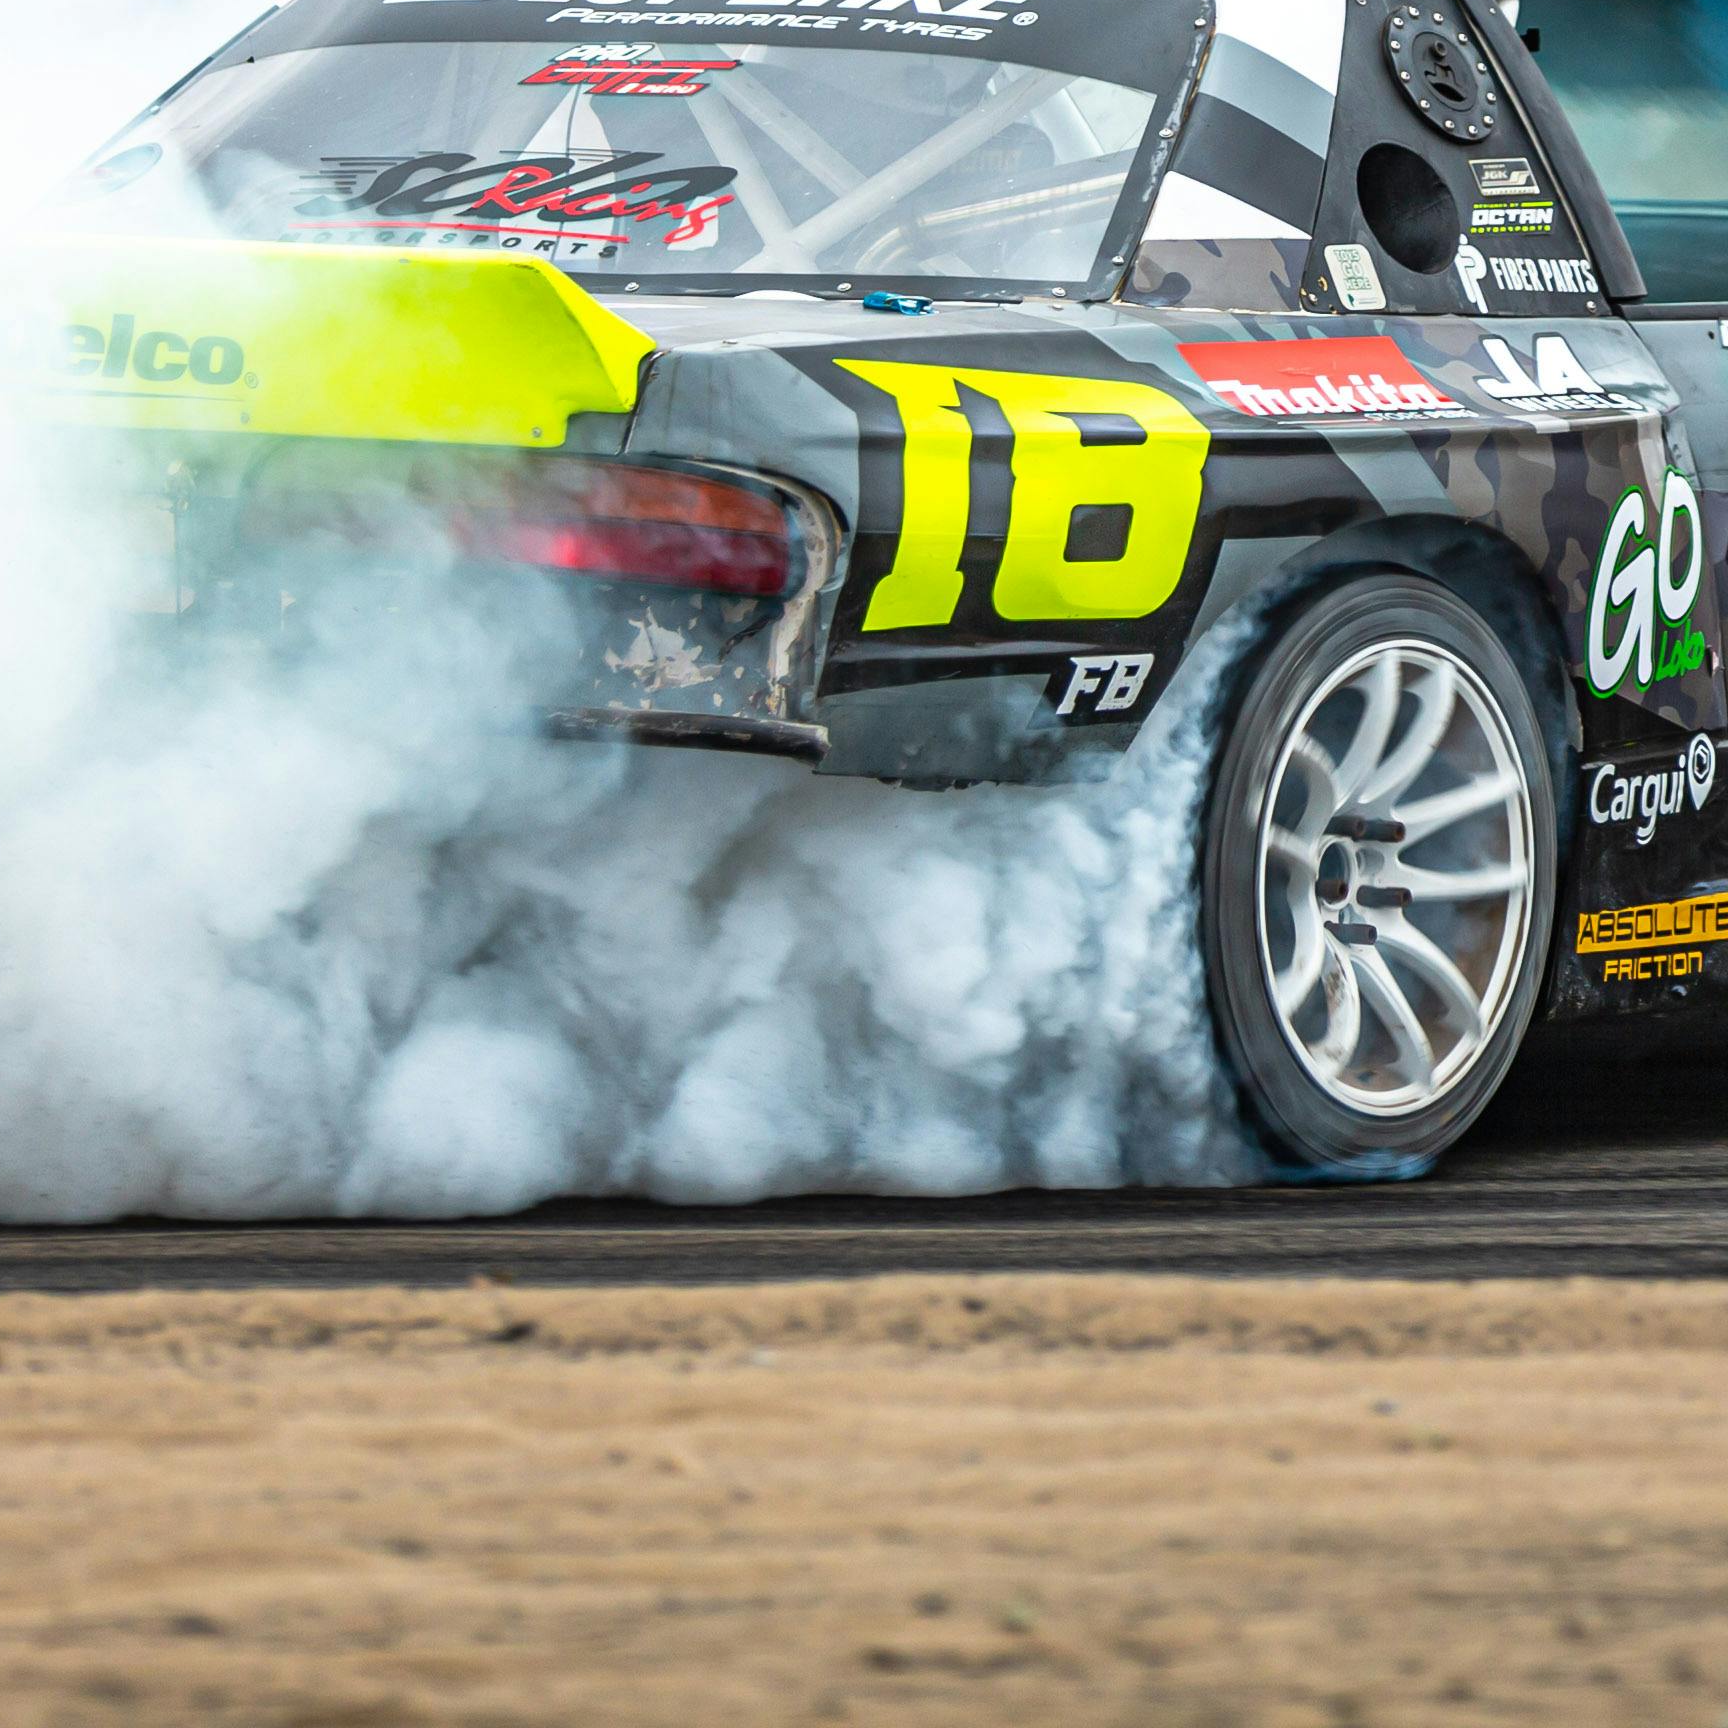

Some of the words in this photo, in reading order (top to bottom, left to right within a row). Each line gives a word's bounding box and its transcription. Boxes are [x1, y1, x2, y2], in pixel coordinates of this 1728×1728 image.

[545, 7, 855, 30] PERFORMANCE
[860, 17, 994, 42] TYRES
[1471, 207, 1554, 226] OCTAN
[1489, 256, 1545, 292] FIBER
[1538, 257, 1600, 294] PARTS
[1503, 393, 1643, 412] WHEELS
[833, 358, 1213, 632] 18
[1056, 653, 1156, 715] FB
[1603, 951, 1703, 982] FRICTION
